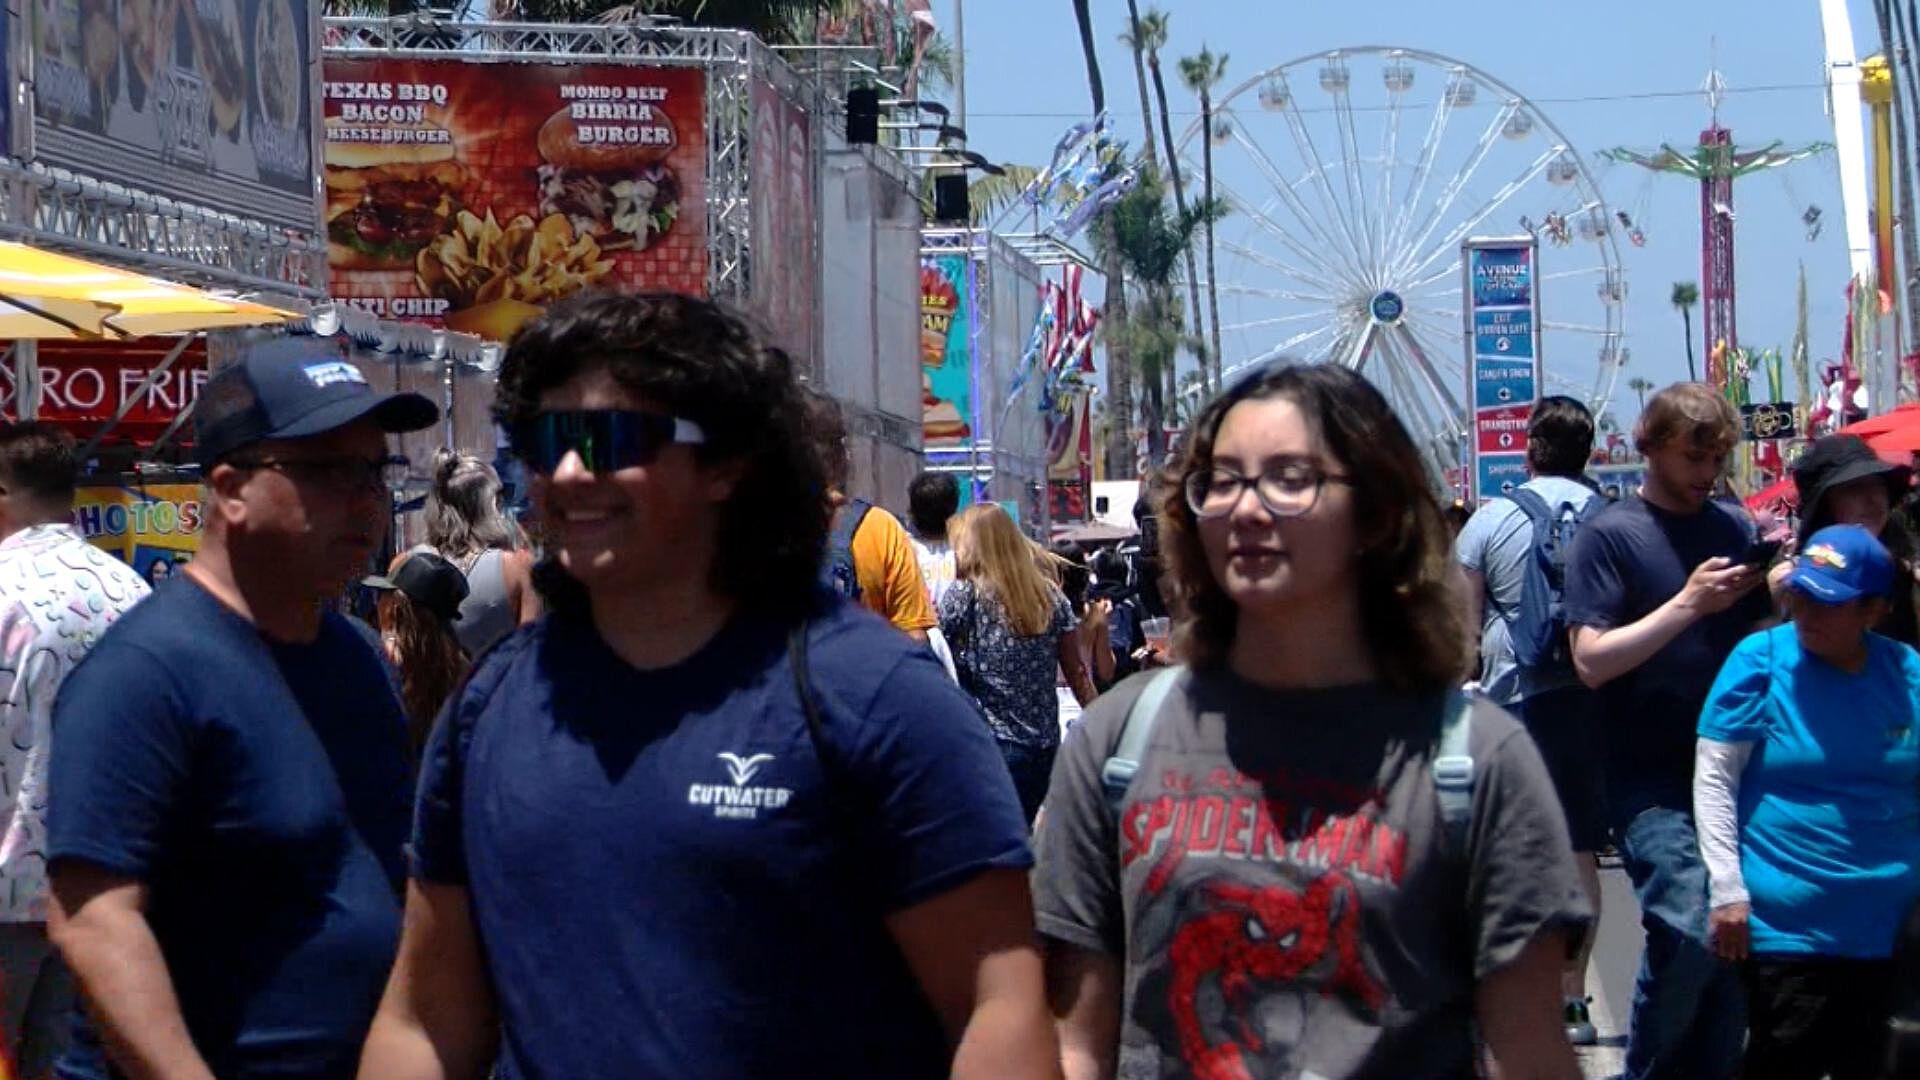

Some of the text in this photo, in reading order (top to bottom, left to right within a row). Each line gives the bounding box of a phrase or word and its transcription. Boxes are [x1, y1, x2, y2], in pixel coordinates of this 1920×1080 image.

[322, 82, 447, 104] TEXAS BBQ
[561, 84, 668, 100] MONDO BEEF
[342, 103, 423, 121] BACON
[571, 103, 653, 120] BIRRIA
[326, 128, 450, 142] HEESEBURGER
[578, 126, 670, 144] BURGER
[72, 501, 203, 536] HOTOS
